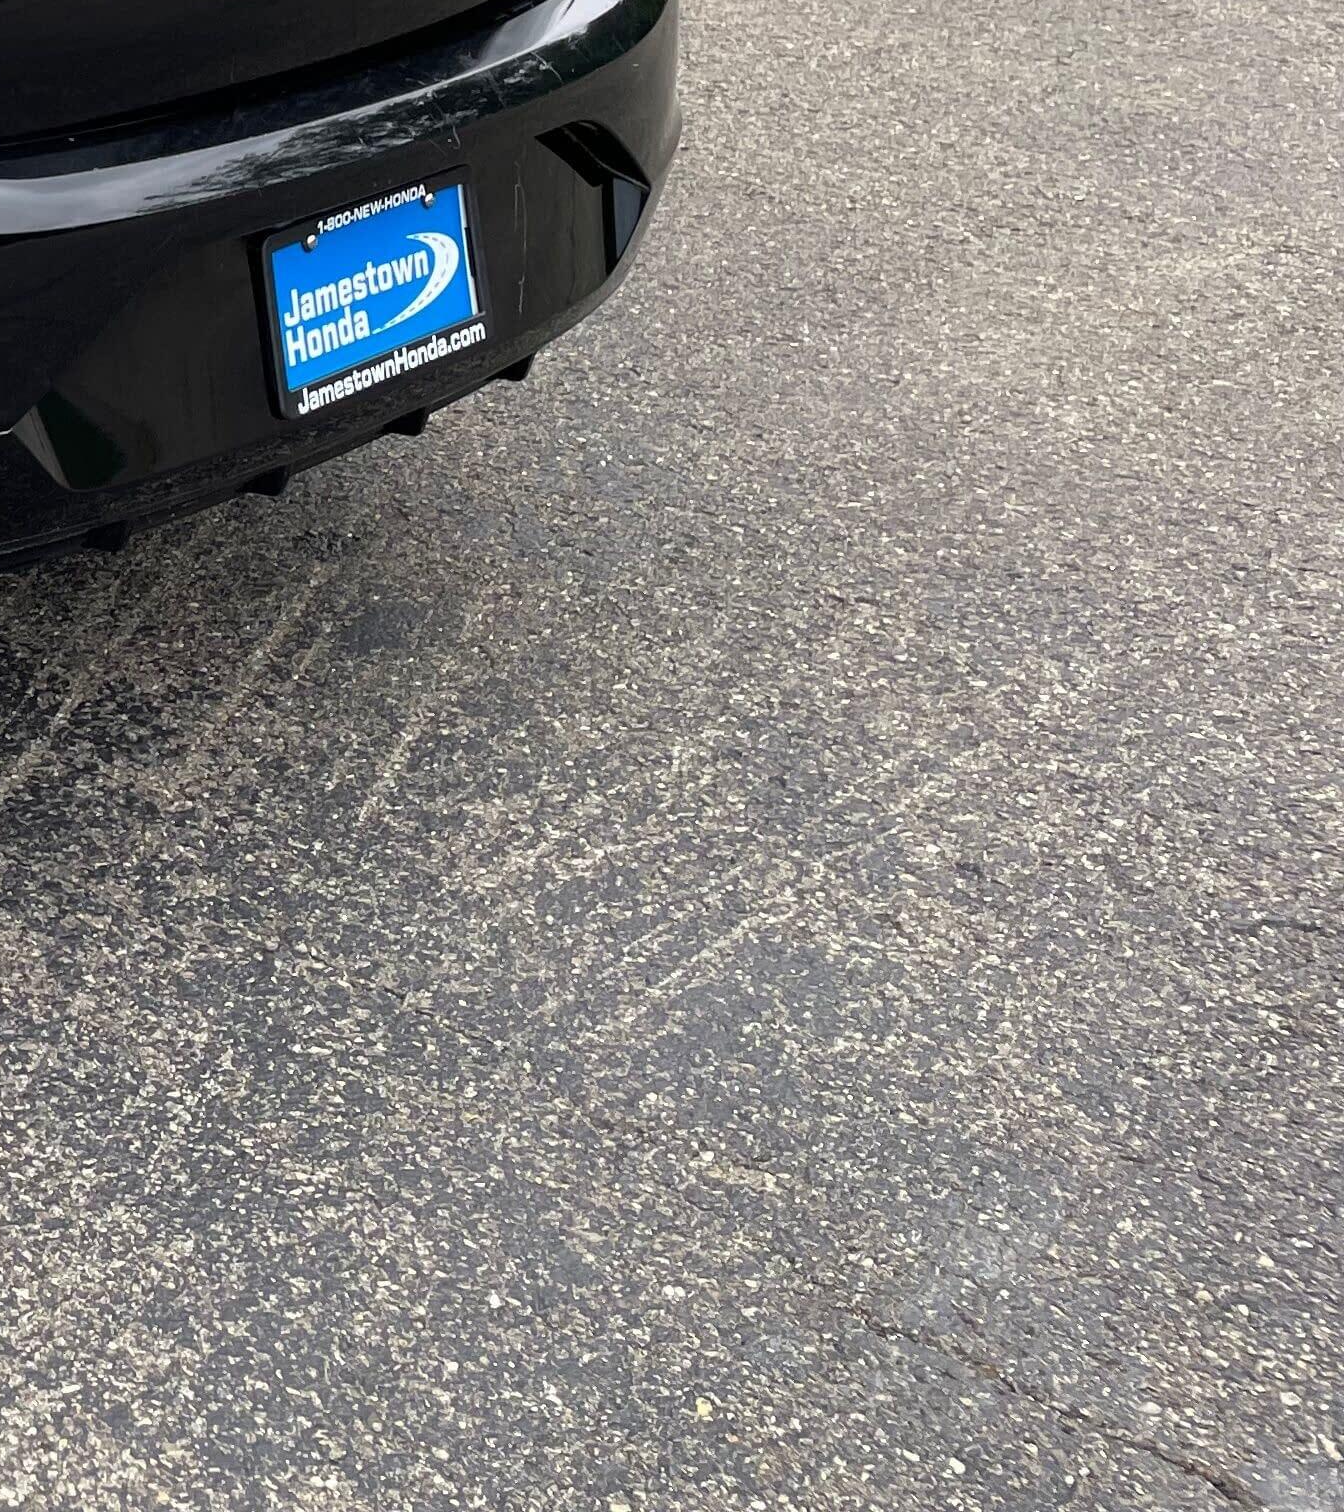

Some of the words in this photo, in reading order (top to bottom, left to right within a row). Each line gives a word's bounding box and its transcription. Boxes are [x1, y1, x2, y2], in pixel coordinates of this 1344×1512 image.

[316, 184, 427, 235] 1-800-NEW-HONDA
[283, 249, 431, 328] Jamestown
[285, 306, 371, 368] Honda
[297, 321, 487, 415] JamestownHonda.com
